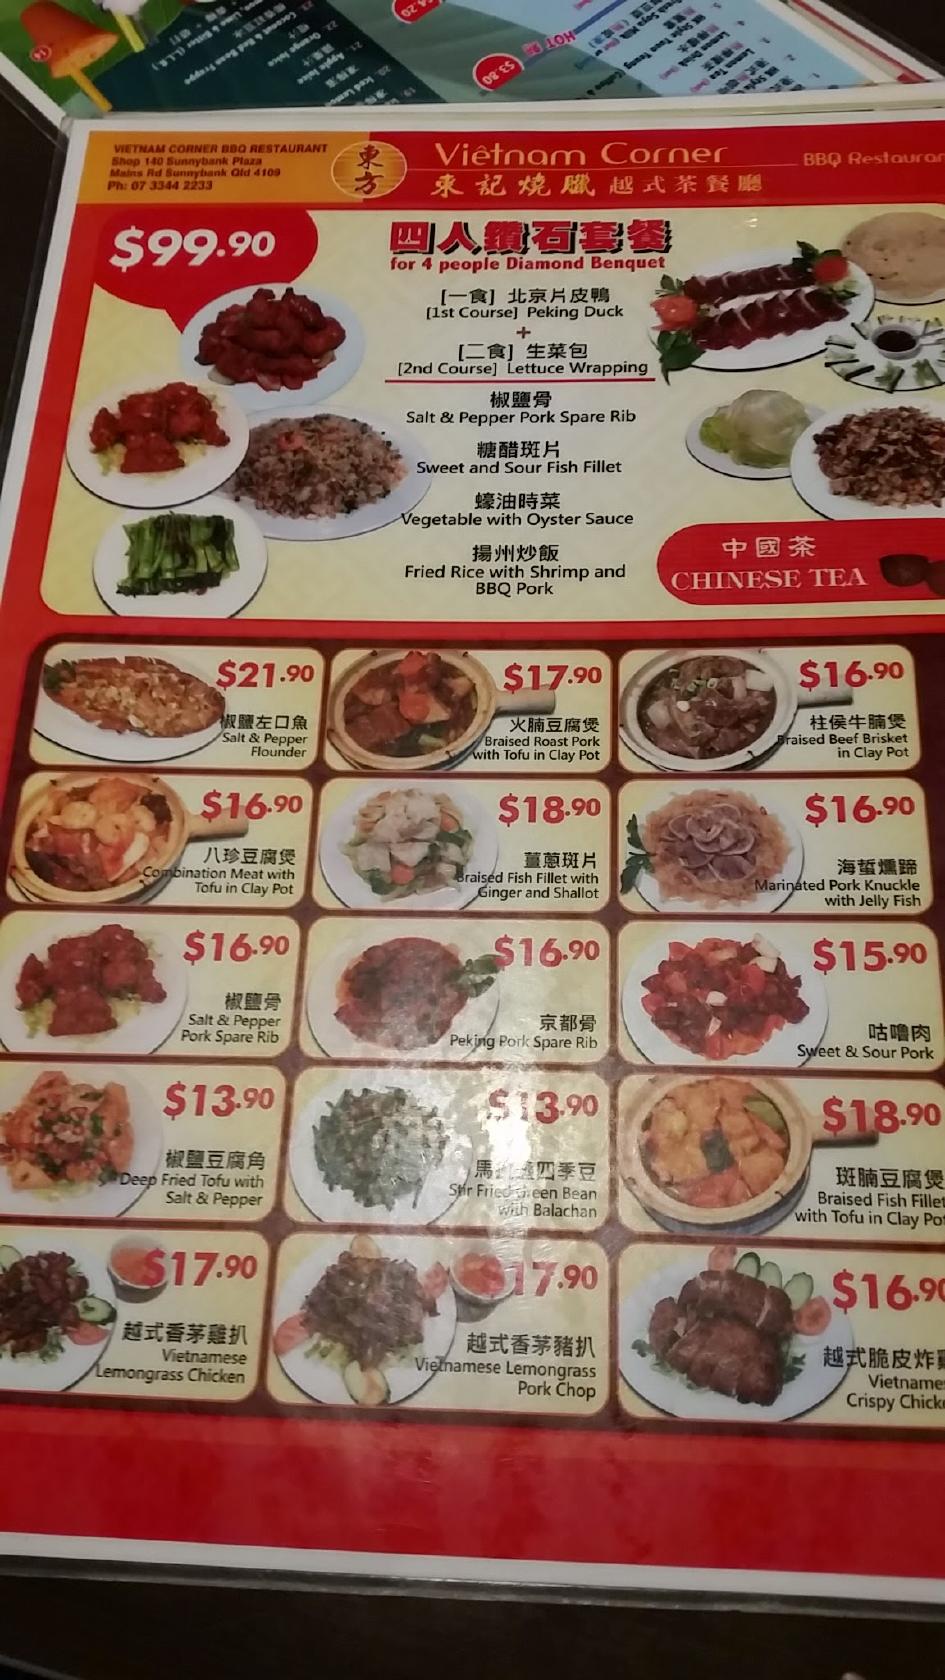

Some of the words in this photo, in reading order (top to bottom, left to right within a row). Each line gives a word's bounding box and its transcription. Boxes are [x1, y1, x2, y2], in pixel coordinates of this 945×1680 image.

[546, 30, 576, 49] HOT
[482, 60, 515, 85] $3.80
[114, 144, 166, 154] VIETNAM
[169, 144, 218, 154] CORNER
[222, 144, 246, 154] BBQ
[250, 144, 328, 154] RESTAURANT
[602, 145, 728, 165] Corner
[112, 157, 140, 167] Shop
[145, 156, 164, 166] 140
[166, 156, 228, 167] Sunnybank
[232, 156, 262, 166] Plaza
[804, 152, 841, 168] BBQ
[110, 168, 144, 178] Mains
[147, 168, 162, 178] Rd
[166, 168, 228, 179] Sunnybank
[231, 168, 250, 178] Qld
[254, 168, 280, 177] 4109
[108, 181, 127, 190] Ph:
[131, 181, 147, 190] 07
[150, 181, 179, 190] 3344
[183, 181, 212, 190] 2233
[390, 219, 672, 255] 四人鑽石套餐
[108, 225, 276, 272] $99.90
[390, 257, 416, 270] for
[422, 257, 432, 270] 4
[439, 256, 499, 273] people
[506, 256, 584, 270] Diamond
[591, 256, 666, 272] Benquet
[508, 287, 610, 304] 北京片皮鴨
[427, 306, 455, 320] [1st
[459, 306, 519, 320] Course]
[527, 306, 578, 320] Peking
[584, 306, 624, 318] Duck
[526, 342, 588, 360] 生菜包
[398, 362, 433, 376] [2nd
[438, 362, 498, 376] Course]
[507, 362, 565, 375] Lettuce
[570, 361, 649, 376] Wrapping
[490, 391, 552, 409] 椒鹽骨
[406, 411, 436, 424] Salt
[440, 412, 454, 424] &
[459, 411, 516, 427] Pepper
[520, 411, 556, 424] Pork
[560, 412, 606, 426] Spare
[610, 410, 637, 422] Rib
[477, 440, 560, 459] 糖醋斑片
[416, 462, 465, 474] Sweet
[470, 462, 500, 474] and
[504, 462, 542, 474] Sour
[547, 462, 578, 473] Fish
[583, 461, 622, 473] Fillet
[474, 492, 561, 510] 蠔油時菜
[400, 512, 482, 528] Vegetable
[486, 512, 522, 526] with
[526, 513, 582, 528] Oyster
[586, 512, 634, 526] Sauce
[472, 544, 560, 563] 揚州炒飯
[722, 536, 816, 560] 中國茶
[404, 566, 446, 578] Fried
[450, 566, 484, 578] Rice
[489, 565, 524, 578] with
[530, 565, 590, 582] Shrimp
[594, 564, 626, 578] and
[671, 569, 801, 591] CHINESE
[808, 568, 868, 588] TEA
[476, 583, 512, 598] BBQ
[516, 582, 554, 596] Pork
[216, 659, 314, 691] $21.90
[503, 662, 602, 694] $17.90
[800, 659, 904, 692] $16.90
[510, 717, 600, 734] 火腩豆腐煲
[810, 714, 906, 731] 柱侯牛腩煲
[222, 732, 248, 744] Salt
[248, 732, 260, 744] &
[264, 733, 308, 748] Pepper
[485, 736, 530, 748] Braised
[534, 736, 568, 748] Roast
[572, 735, 600, 748] Pork
[251, 746, 307, 758] Flounder
[472, 749, 500, 761] with
[504, 749, 529, 761] Tofu
[534, 749, 544, 761] in
[549, 749, 576, 763] Clay
[579, 749, 600, 761] Pot
[201, 789, 303, 822] $16.90
[498, 793, 600, 827] $18.90
[806, 793, 915, 827] $16.90
[203, 847, 296, 866] 八珍豆腐煲
[478, 886, 521, 901] Ginger
[525, 887, 550, 899] and
[554, 886, 599, 899] Shallot
[825, 895, 855, 907] with
[860, 895, 890, 909] Jelly
[894, 895, 921, 907] Fish
[184, 930, 290, 965] $16.90
[813, 938, 928, 975] $15.90
[225, 992, 281, 1011] 椒鹽骨
[188, 1014, 214, 1026] Salt
[218, 1014, 229, 1026] &
[233, 1015, 281, 1030] Pepper
[539, 1014, 597, 1032] 京都骨
[181, 1030, 212, 1042] Pork
[215, 1030, 253, 1045] Spare
[258, 1031, 280, 1043] Rib
[163, 1080, 274, 1121] $13.90
[822, 1095, 941, 1136] $18.90
[166, 1150, 266, 1170] 椒鹽豆腐角
[836, 1167, 945, 1190] 斑腩豆腐煲
[166, 1191, 192, 1204] Salt
[196, 1192, 209, 1204] &
[213, 1193, 263, 1208] Pepper
[122, 1321, 248, 1346] 越式香茅雞扒
[467, 1332, 596, 1358] 越式香茅豬扒
[162, 1348, 248, 1366] Vietnamese
[96, 1366, 184, 1384] Lemongrass
[188, 1368, 246, 1384] Chicken
[415, 1357, 501, 1374] Vietnamese
[506, 1363, 596, 1384] Lemongrass
[518, 1380, 550, 1396] Pork
[556, 1382, 596, 1401] Chop
